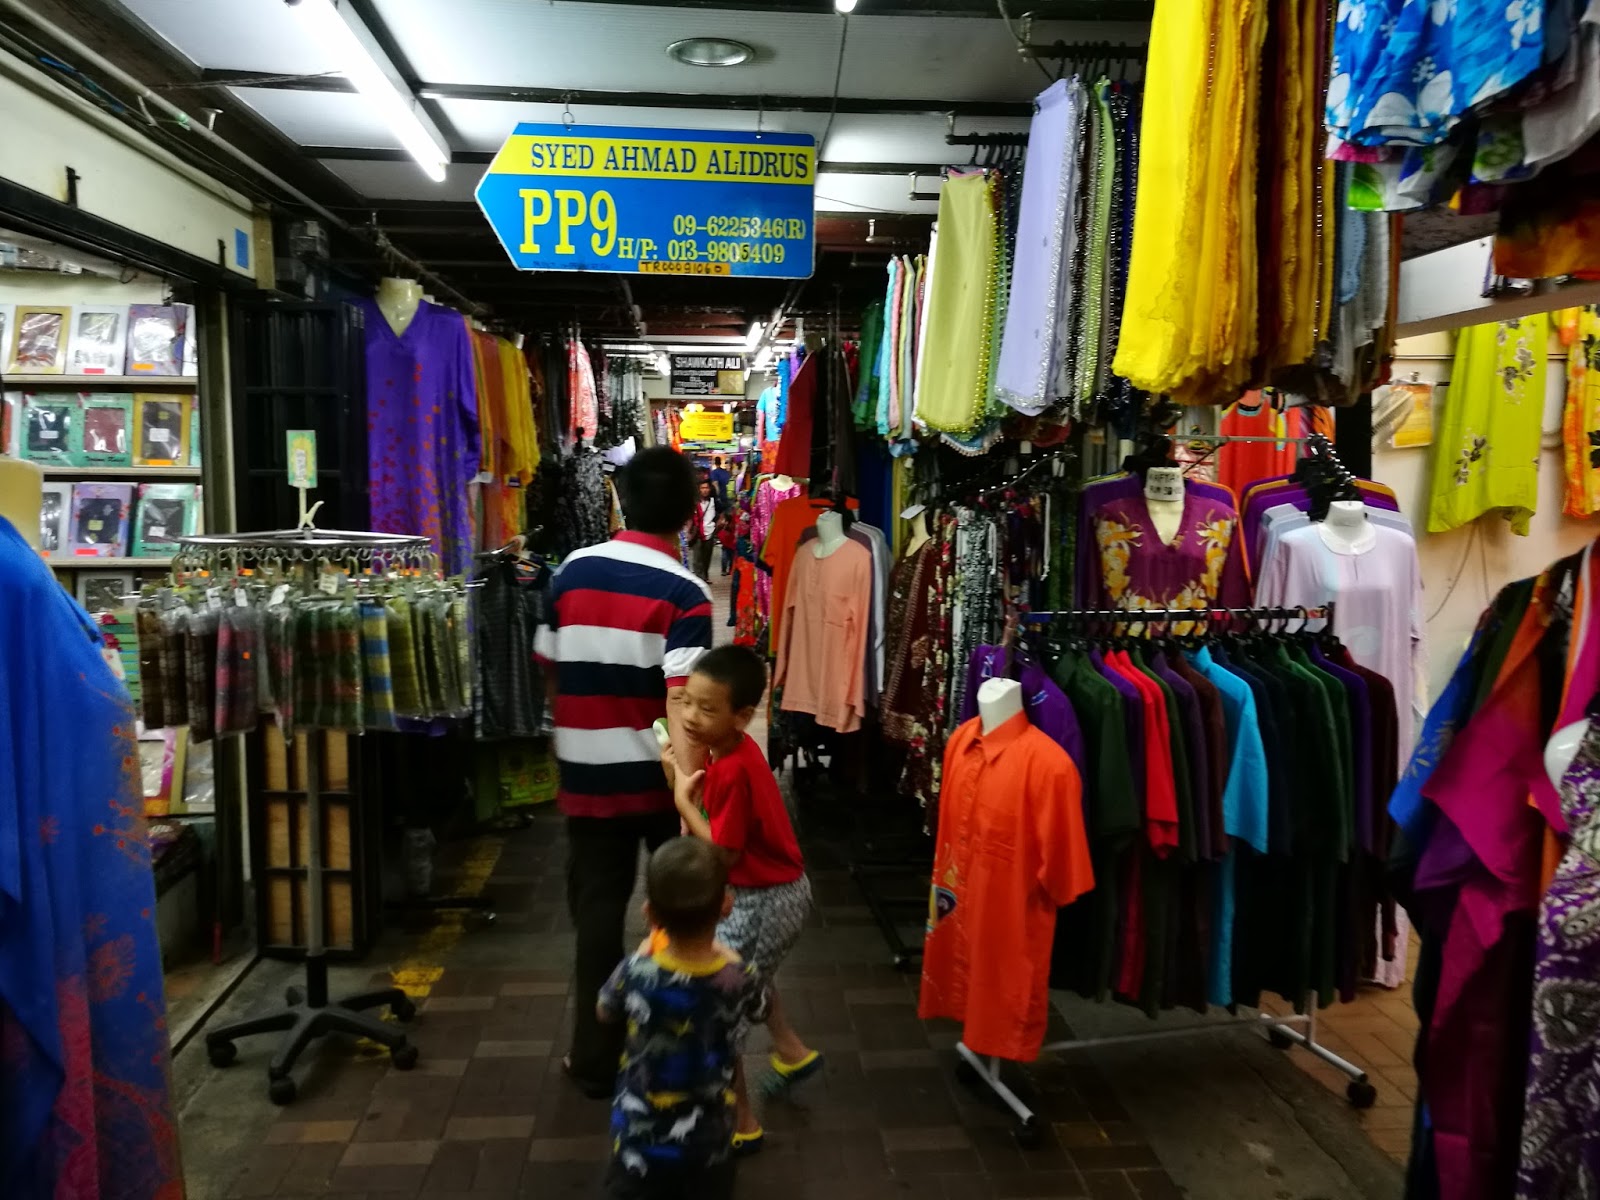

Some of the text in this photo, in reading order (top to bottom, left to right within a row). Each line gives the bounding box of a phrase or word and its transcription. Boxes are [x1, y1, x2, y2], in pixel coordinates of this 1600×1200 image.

[531, 143, 808, 178] SYED AHMAD ALIDRUS
[519, 188, 618, 257] PP9
[617, 237, 658, 260] H/P:
[725, 358, 741, 369] ALI
